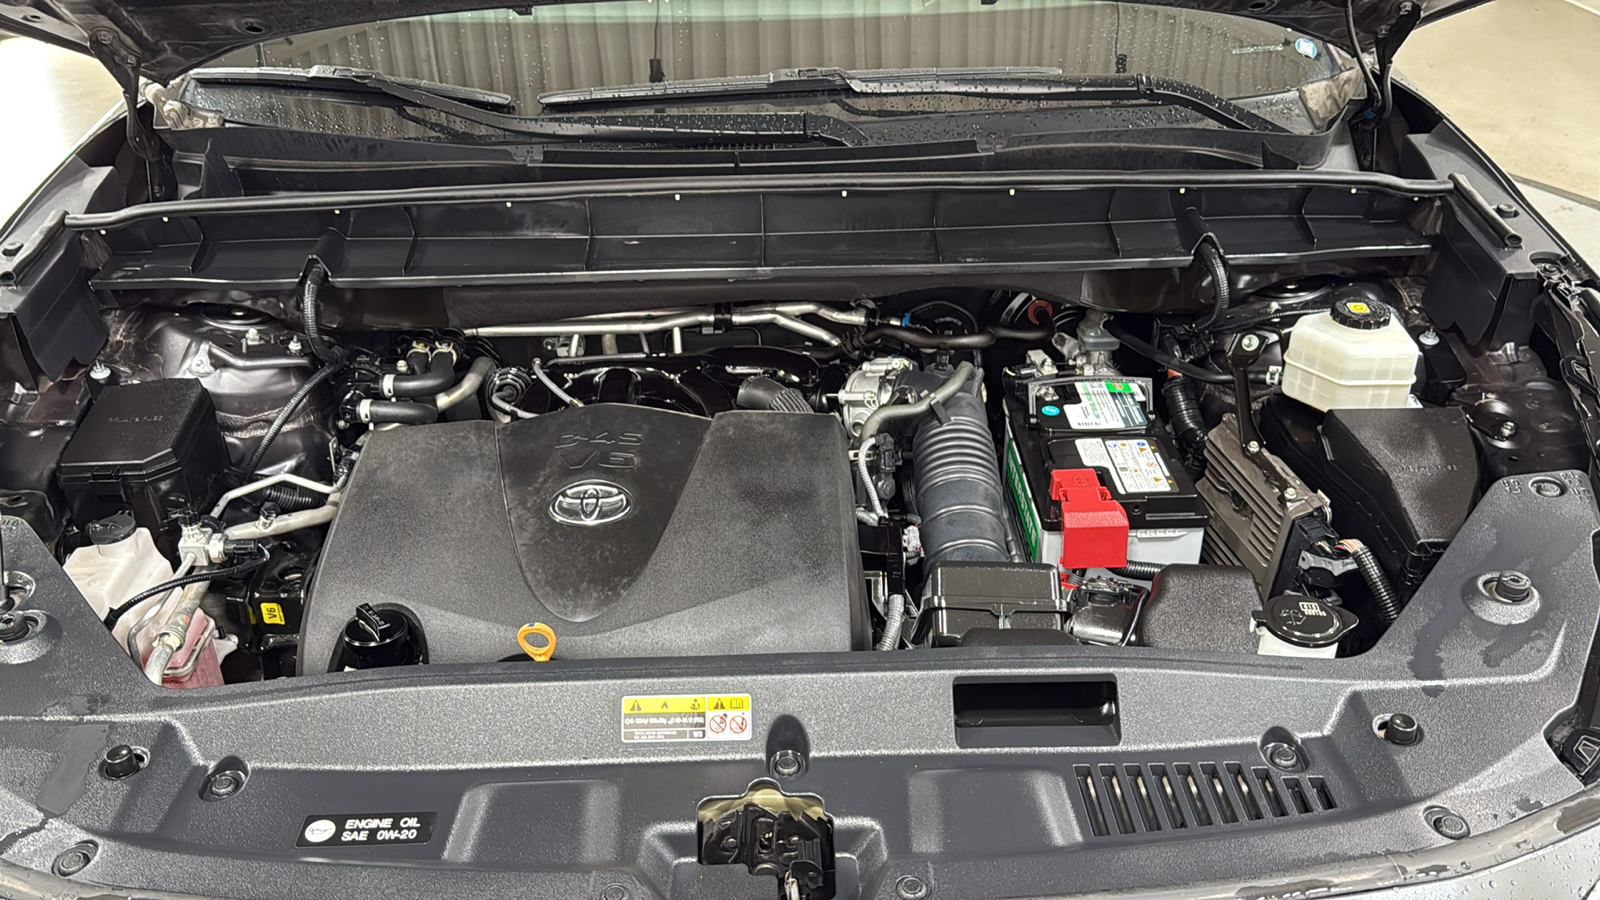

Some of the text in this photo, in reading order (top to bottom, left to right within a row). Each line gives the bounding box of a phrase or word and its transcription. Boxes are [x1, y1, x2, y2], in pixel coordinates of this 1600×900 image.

[559, 449, 637, 470] V6
[345, 817, 421, 830] ENGINE OIL
[341, 829, 417, 842] SAE 0W-20
